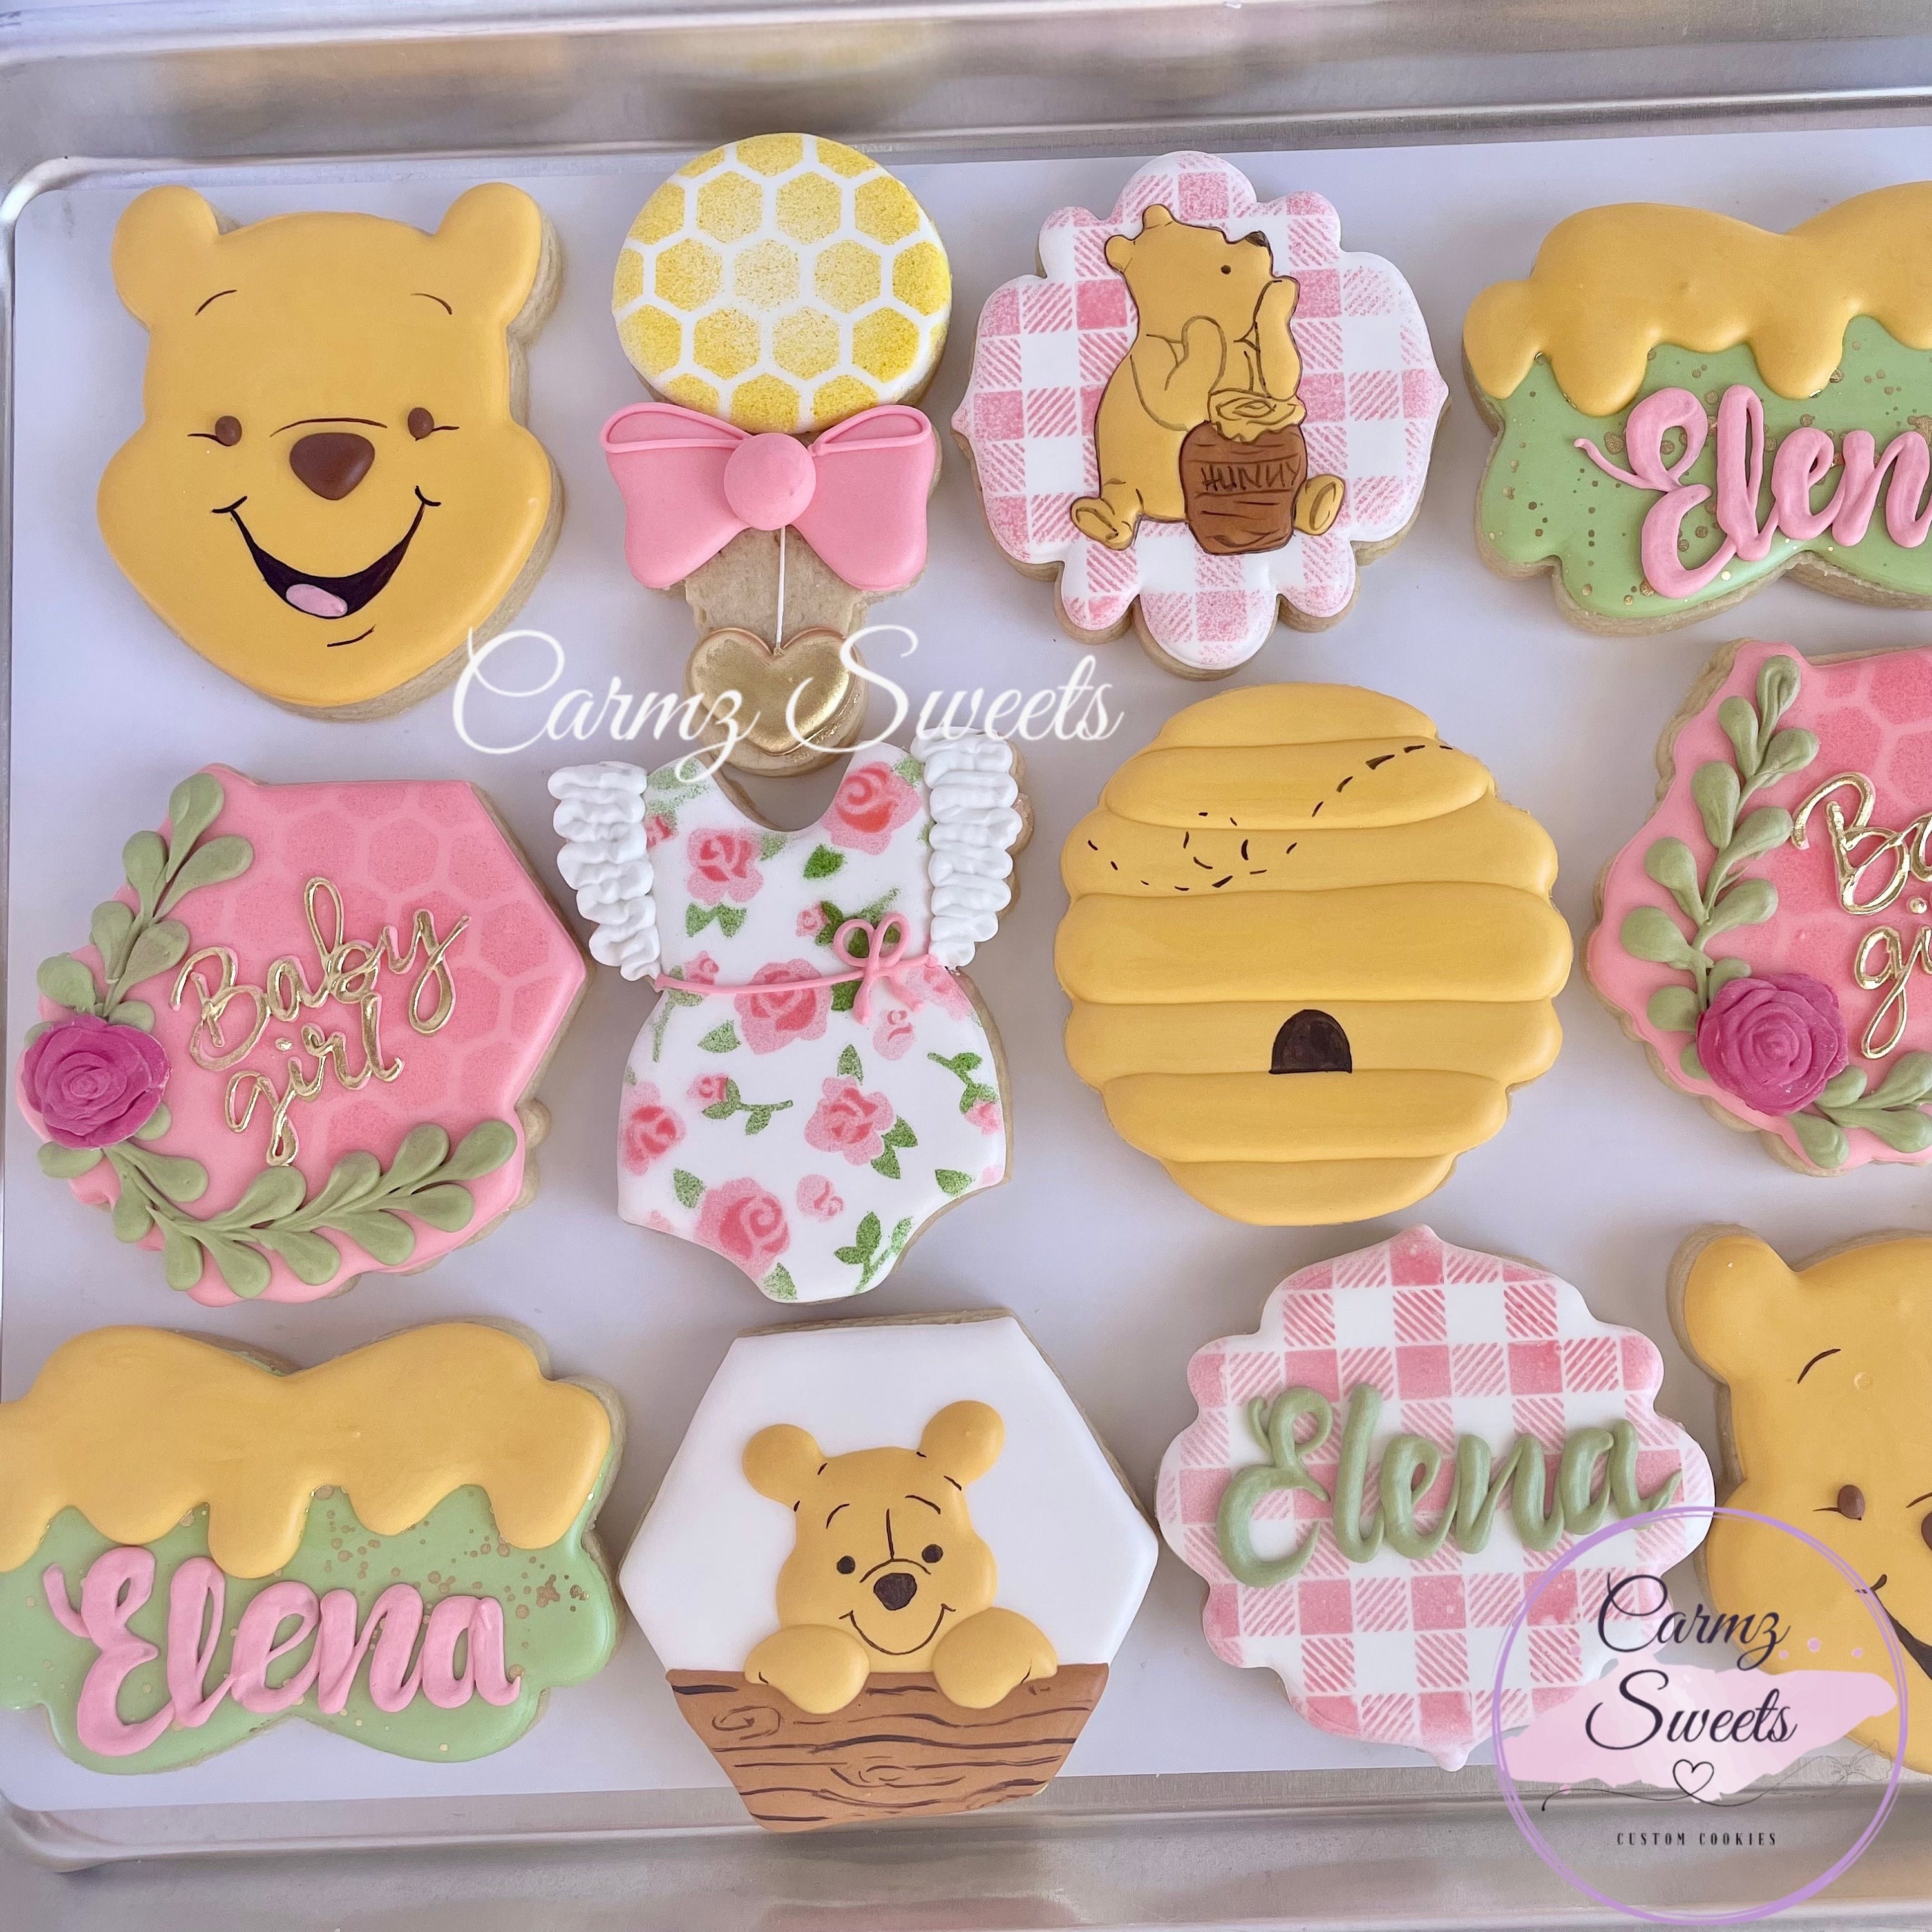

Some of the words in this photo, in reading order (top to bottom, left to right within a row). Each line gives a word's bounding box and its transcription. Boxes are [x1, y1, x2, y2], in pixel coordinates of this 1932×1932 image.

[1200, 454, 1302, 491] HUNNY
[170, 876, 471, 1072] Baby
[225, 992, 405, 1166] girl
[1216, 1382, 1683, 1588] Elena
[43, 1546, 521, 1756] Elena
